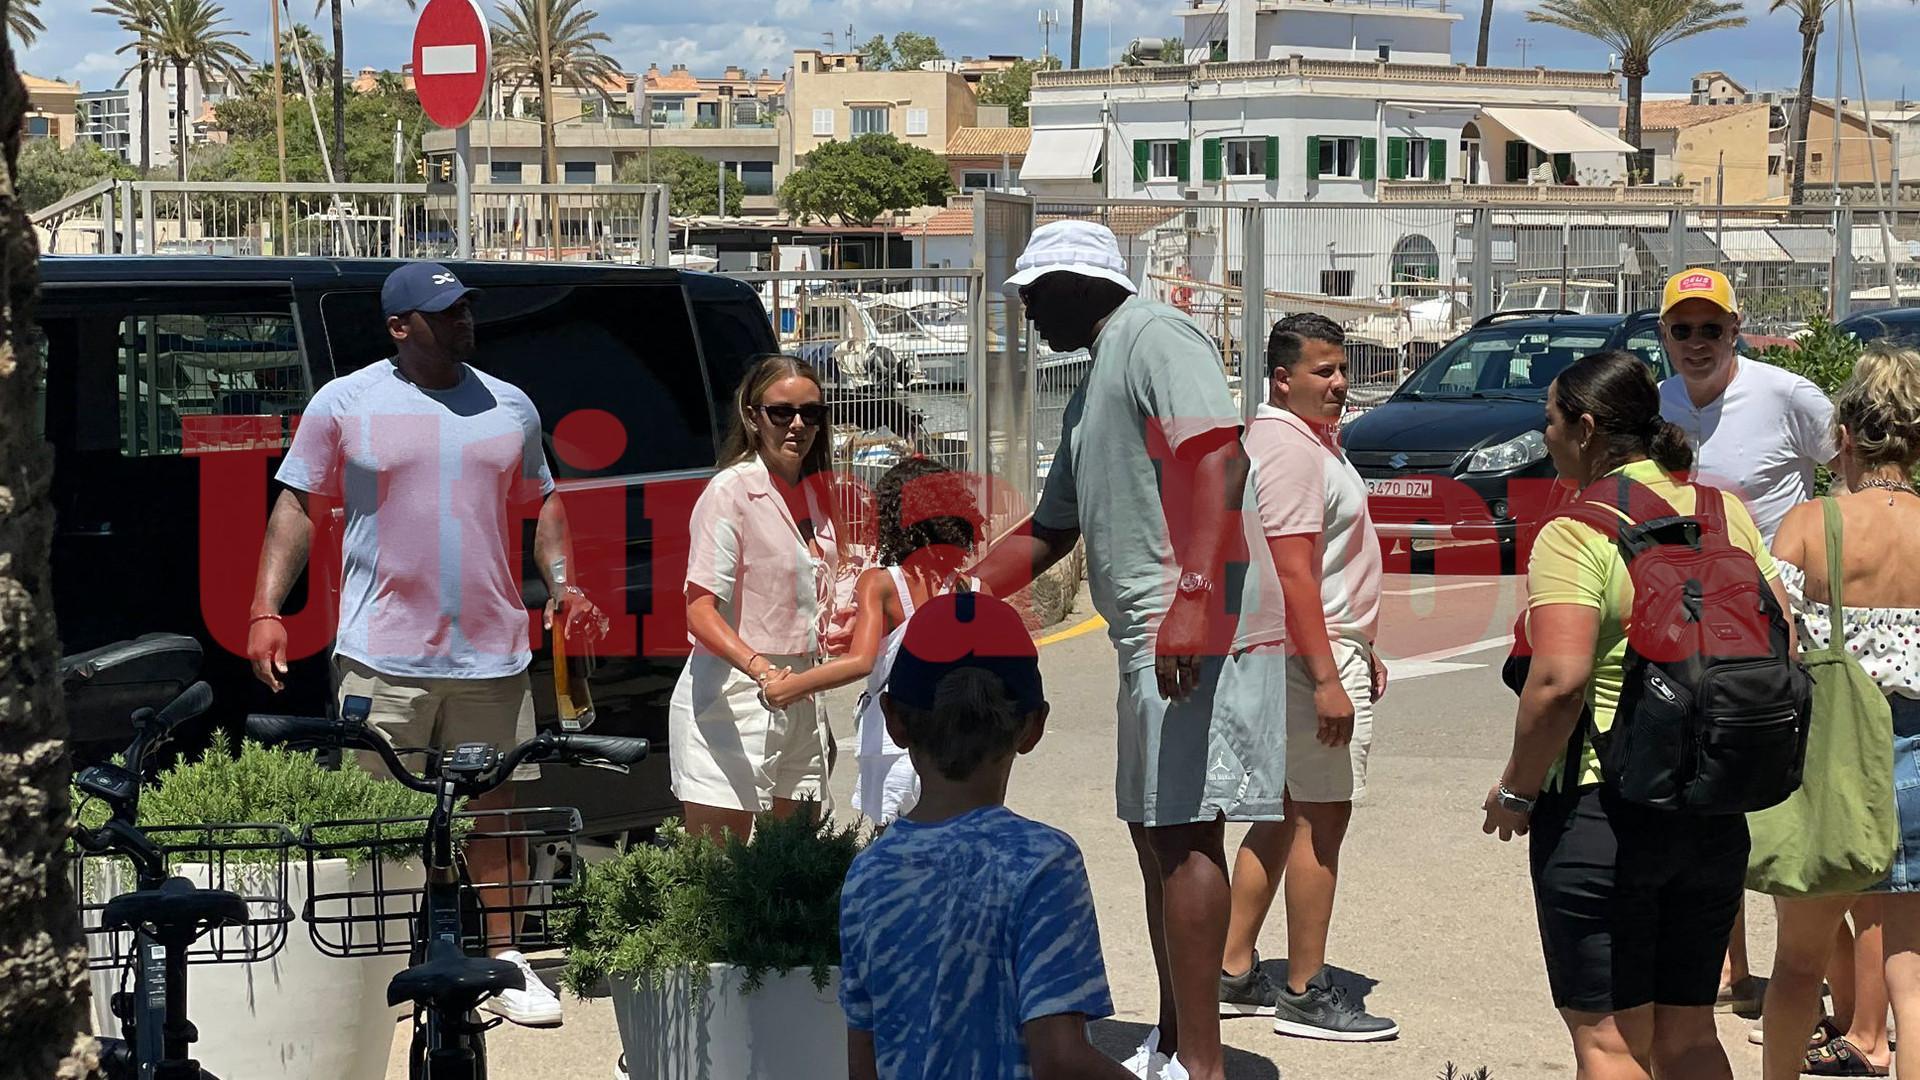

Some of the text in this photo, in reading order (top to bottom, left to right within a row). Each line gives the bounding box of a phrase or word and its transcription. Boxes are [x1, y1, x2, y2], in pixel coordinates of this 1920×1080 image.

[1682, 276, 1709, 285] DEUS
[1368, 482, 1429, 497] 3470 DZM
